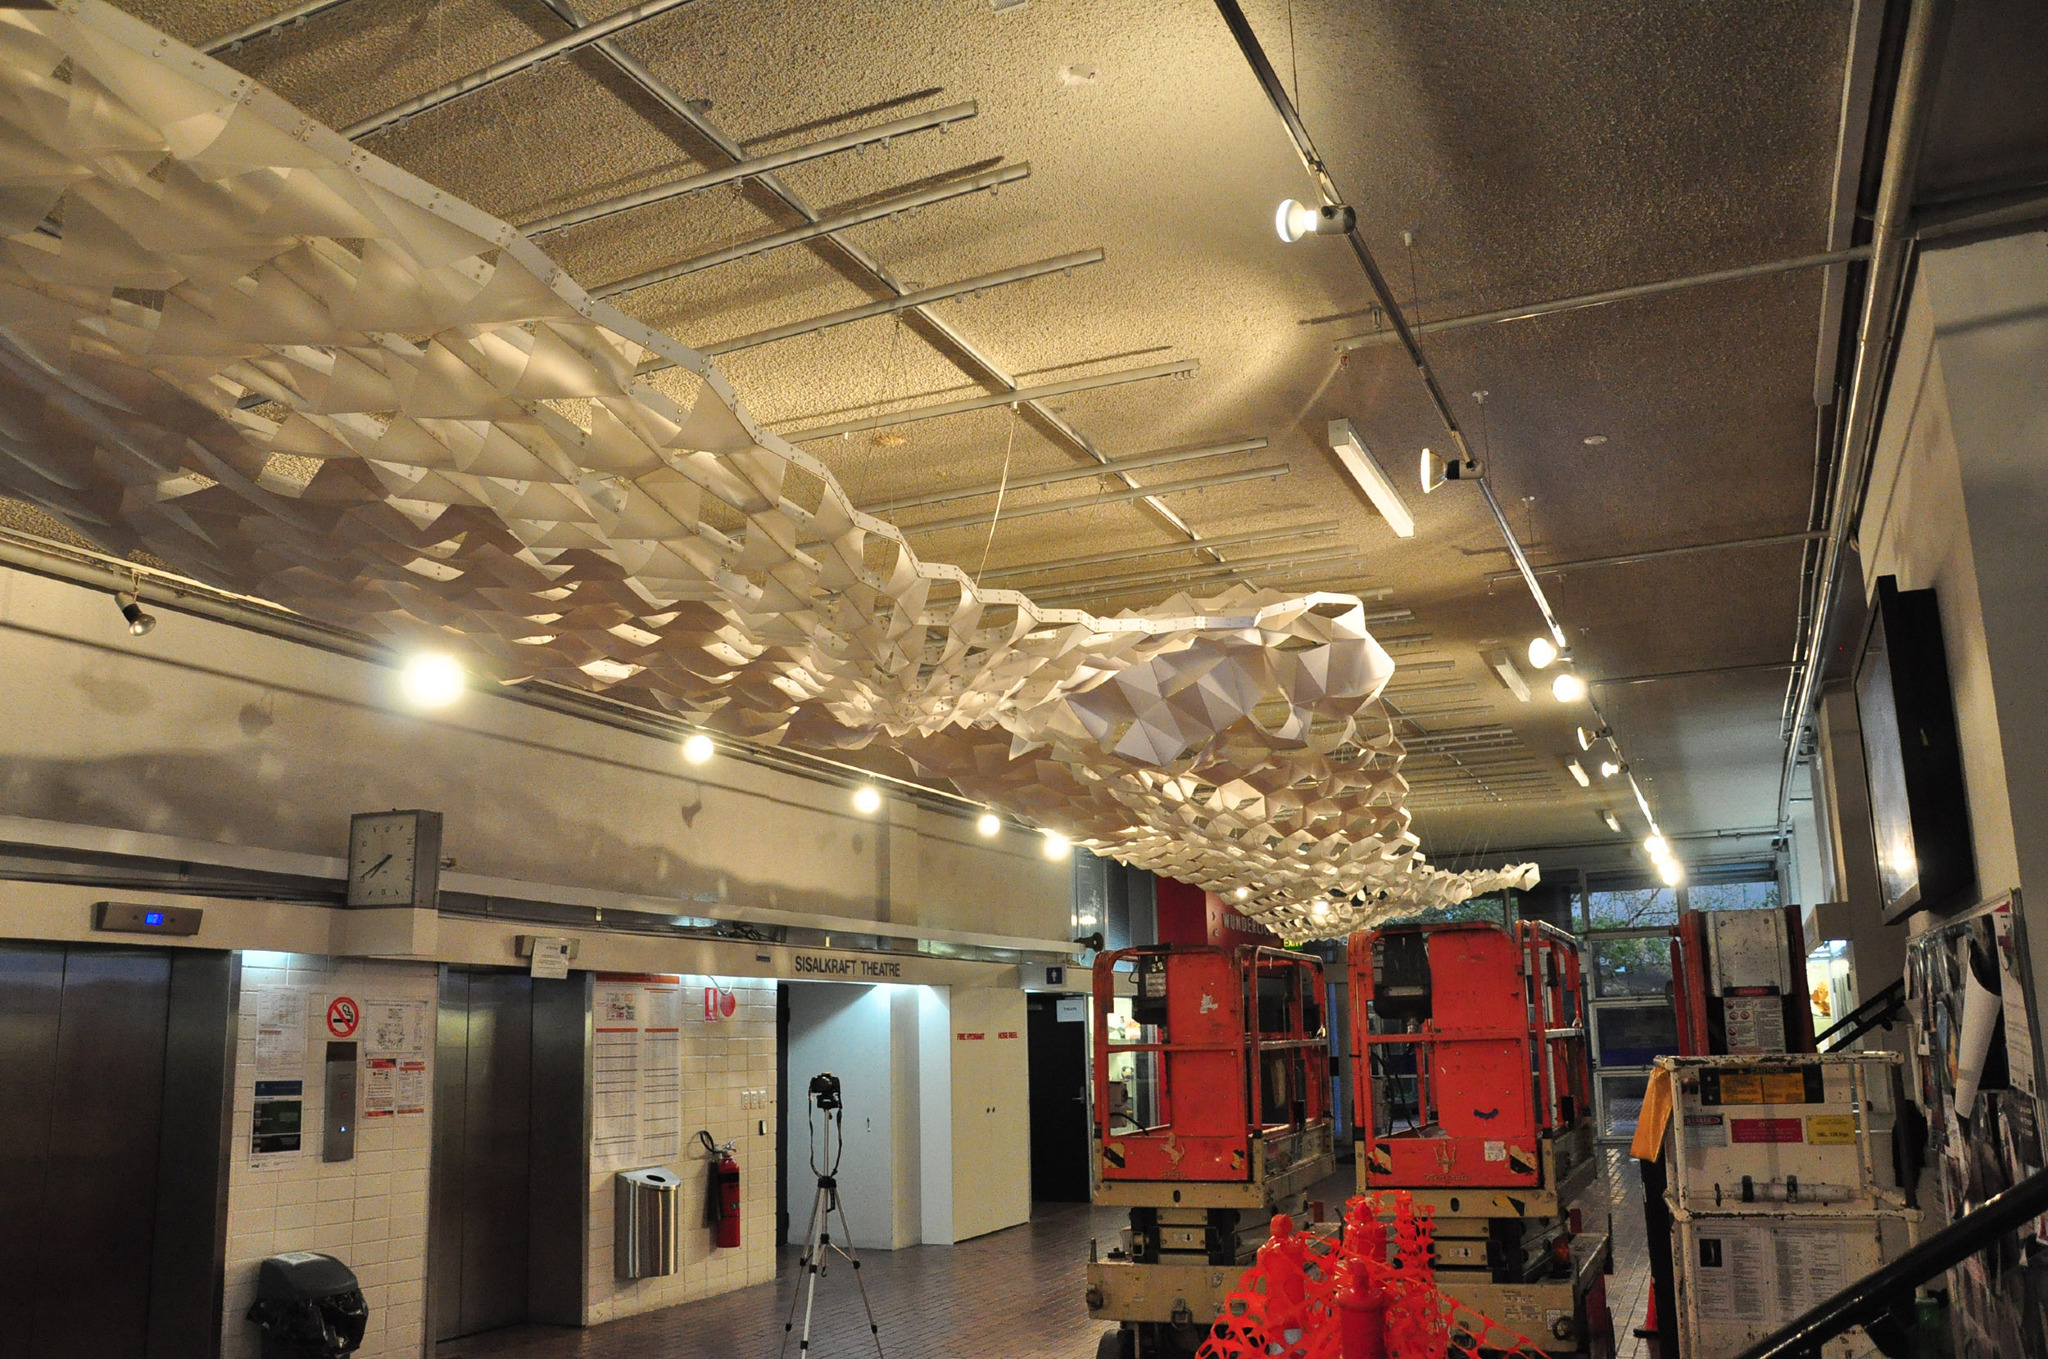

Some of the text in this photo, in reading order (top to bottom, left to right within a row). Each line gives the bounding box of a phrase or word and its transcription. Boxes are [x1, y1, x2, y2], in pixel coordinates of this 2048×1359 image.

[1222, 913, 1275, 937] WUNDERLIC
[795, 955, 901, 978] SISALKRAFT THEATRE
